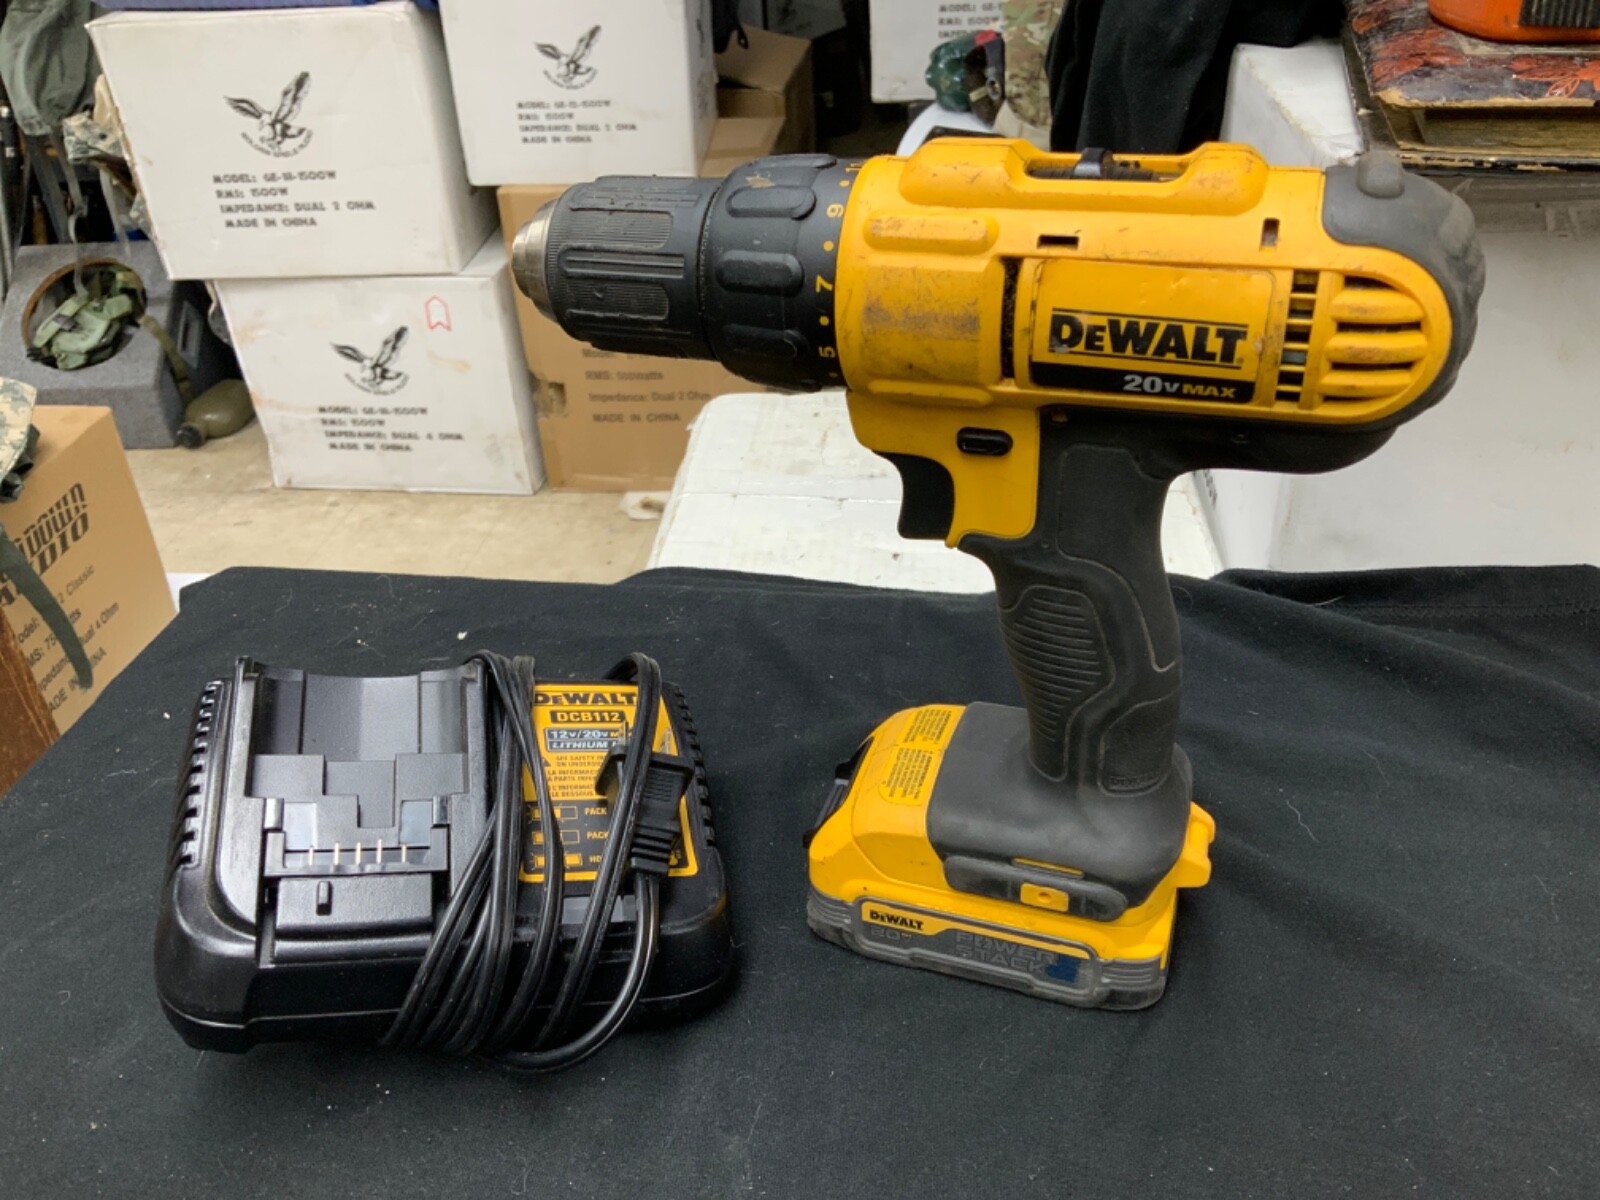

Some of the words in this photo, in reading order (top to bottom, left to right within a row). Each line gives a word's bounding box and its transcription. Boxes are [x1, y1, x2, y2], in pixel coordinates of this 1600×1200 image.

[294, 201, 326, 212] DUAL
[225, 218, 259, 228] MADE
[264, 218, 277, 227] IN
[282, 216, 317, 227] CHINA
[815, 274, 833, 294] 7
[1050, 314, 1248, 365] DEWALT
[818, 345, 836, 359] 5
[1123, 374, 1180, 394] 20V
[1182, 382, 1237, 398] MAX
[651, 391, 675, 401] Dual
[592, 413, 625, 422] MADE
[630, 413, 641, 422] IN
[646, 412, 681, 422] CHINA
[535, 693, 638, 705] DEWALT
[556, 712, 621, 722] DCB112
[552, 740, 609, 749] LITHIUM
[584, 807, 607, 816] PACK
[869, 909, 924, 931] DEWALT
[955, 931, 1057, 966] POWER
[955, 944, 1047, 974] STACK
